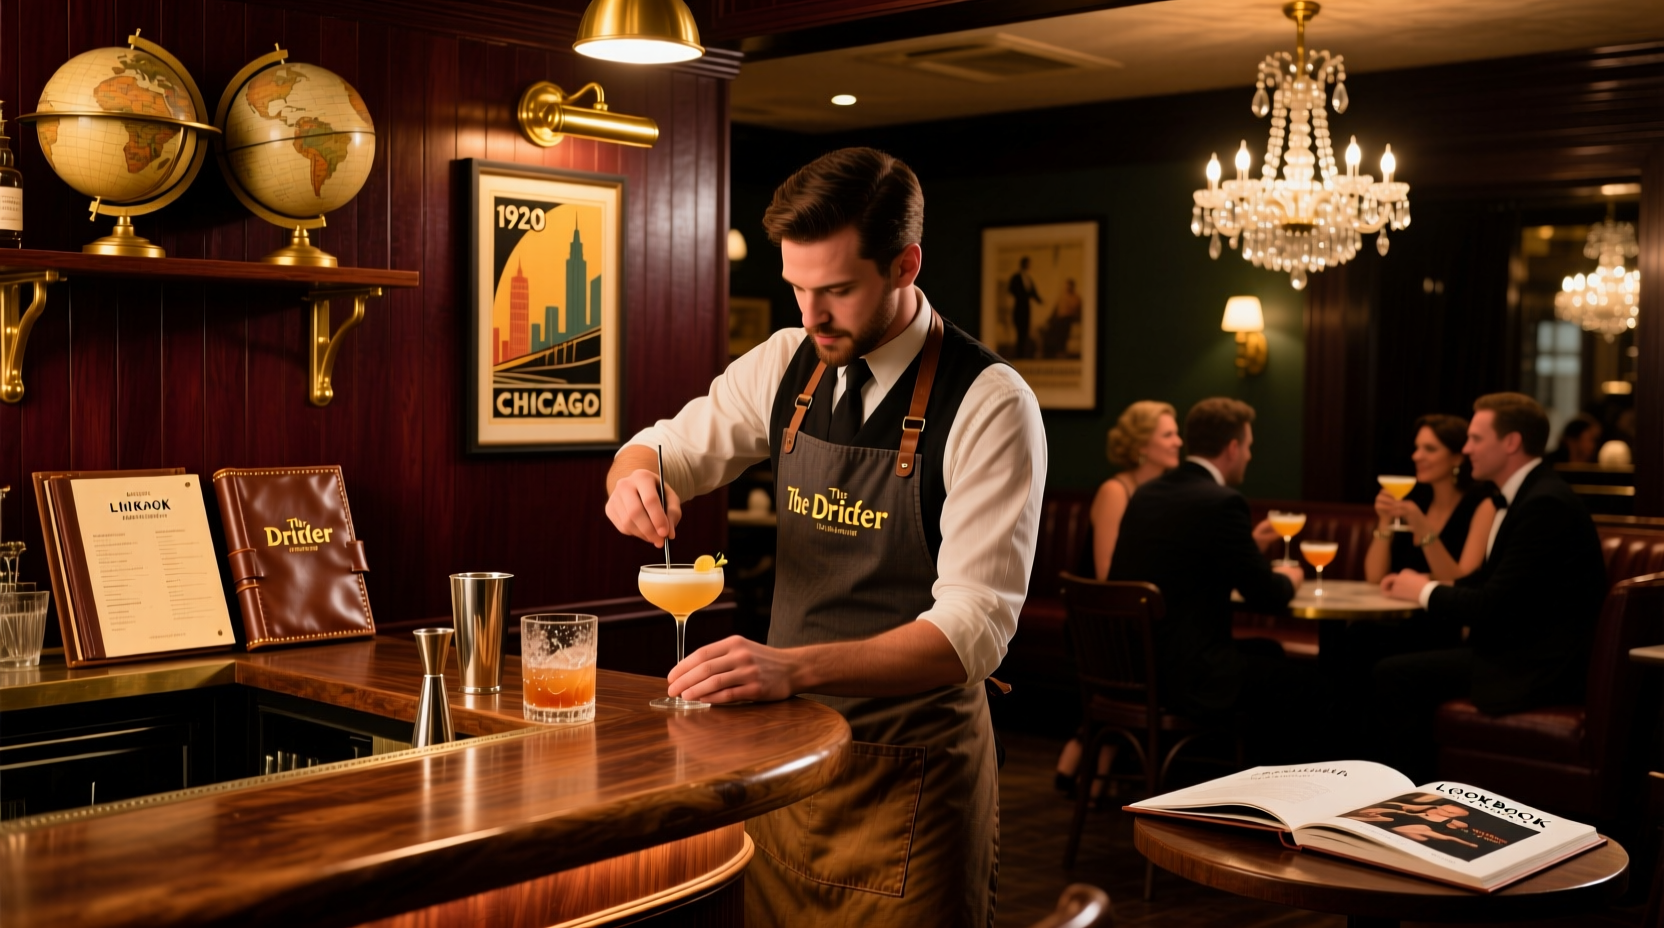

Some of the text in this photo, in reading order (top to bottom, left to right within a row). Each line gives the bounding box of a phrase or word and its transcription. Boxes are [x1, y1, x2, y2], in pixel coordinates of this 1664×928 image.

[497, 204, 546, 232] 1920
[496, 391, 600, 416] CHICAGO
[787, 485, 810, 515] The
[1435, 783, 1551, 828] LOOKBOOK
